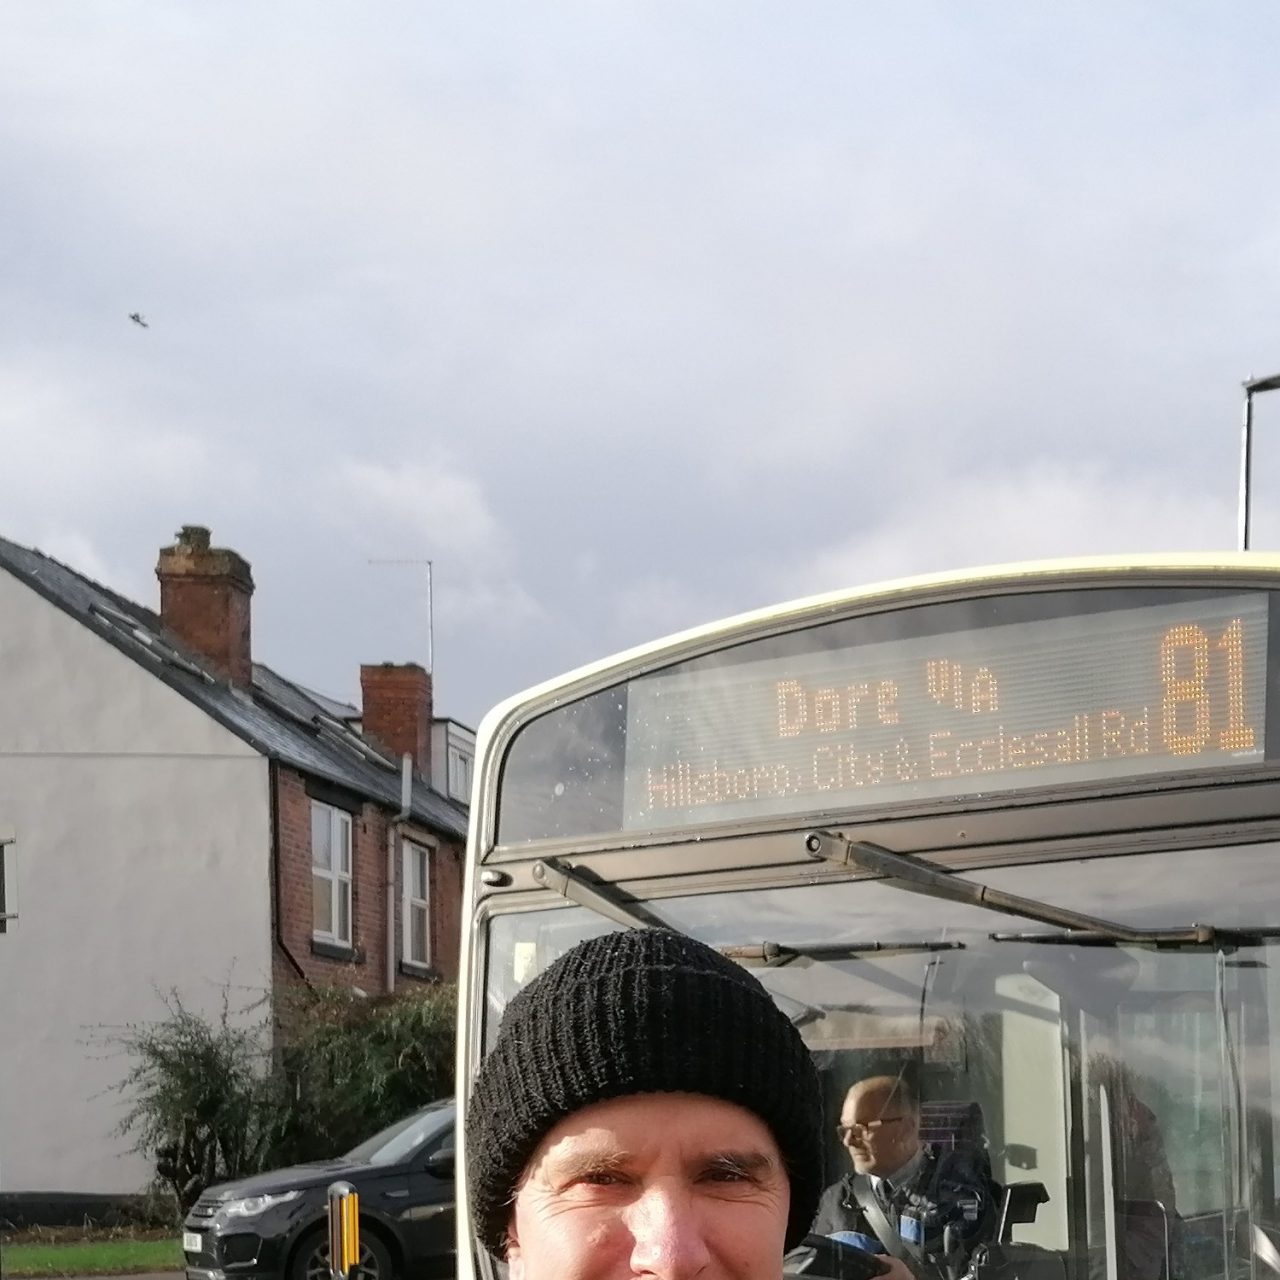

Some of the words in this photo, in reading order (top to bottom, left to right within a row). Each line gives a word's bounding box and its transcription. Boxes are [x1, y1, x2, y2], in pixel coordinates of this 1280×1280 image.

[777, 678, 899, 737] Dore
[1161, 616, 1255, 756] 81
[930, 714, 1088, 777] Ecclesall
[1103, 707, 1148, 758] Rd
